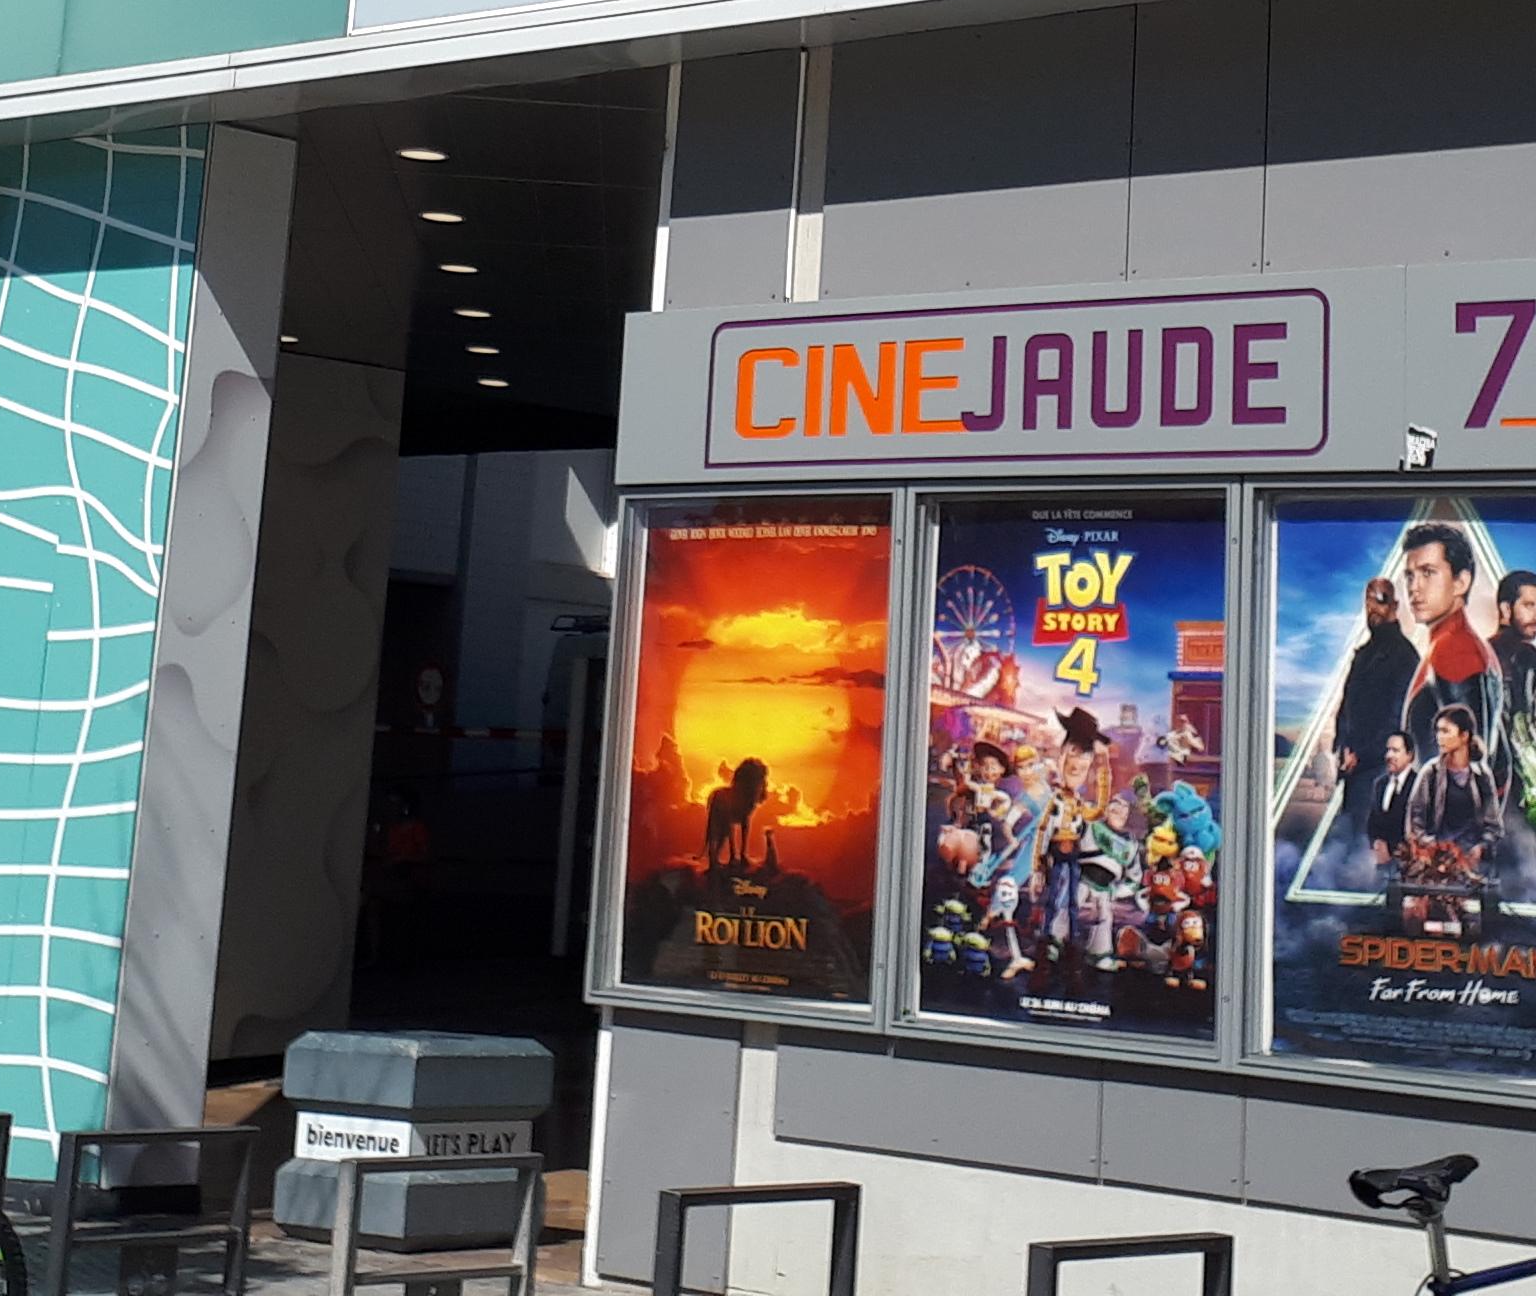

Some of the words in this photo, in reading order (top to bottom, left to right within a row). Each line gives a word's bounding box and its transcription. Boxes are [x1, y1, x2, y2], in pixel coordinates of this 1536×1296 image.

[1455, 298, 1536, 429] 7
[1031, 509, 1050, 520] QUE
[1051, 509, 1063, 520] LA
[1082, 509, 1134, 520] COMMENCE
[1044, 527, 1080, 547] Disney
[1084, 530, 1119, 542] PIXAR
[1034, 551, 1135, 608] TOY
[1042, 612, 1121, 632] STORY
[1055, 636, 1100, 696] 4
[694, 910, 740, 945] ROI
[743, 916, 810, 951] LION
[1368, 977, 1403, 1002] Far
[1403, 978, 1455, 1003] From
[306, 1123, 401, 1155] bienvenue
[468, 1132, 518, 1154] PLAY
